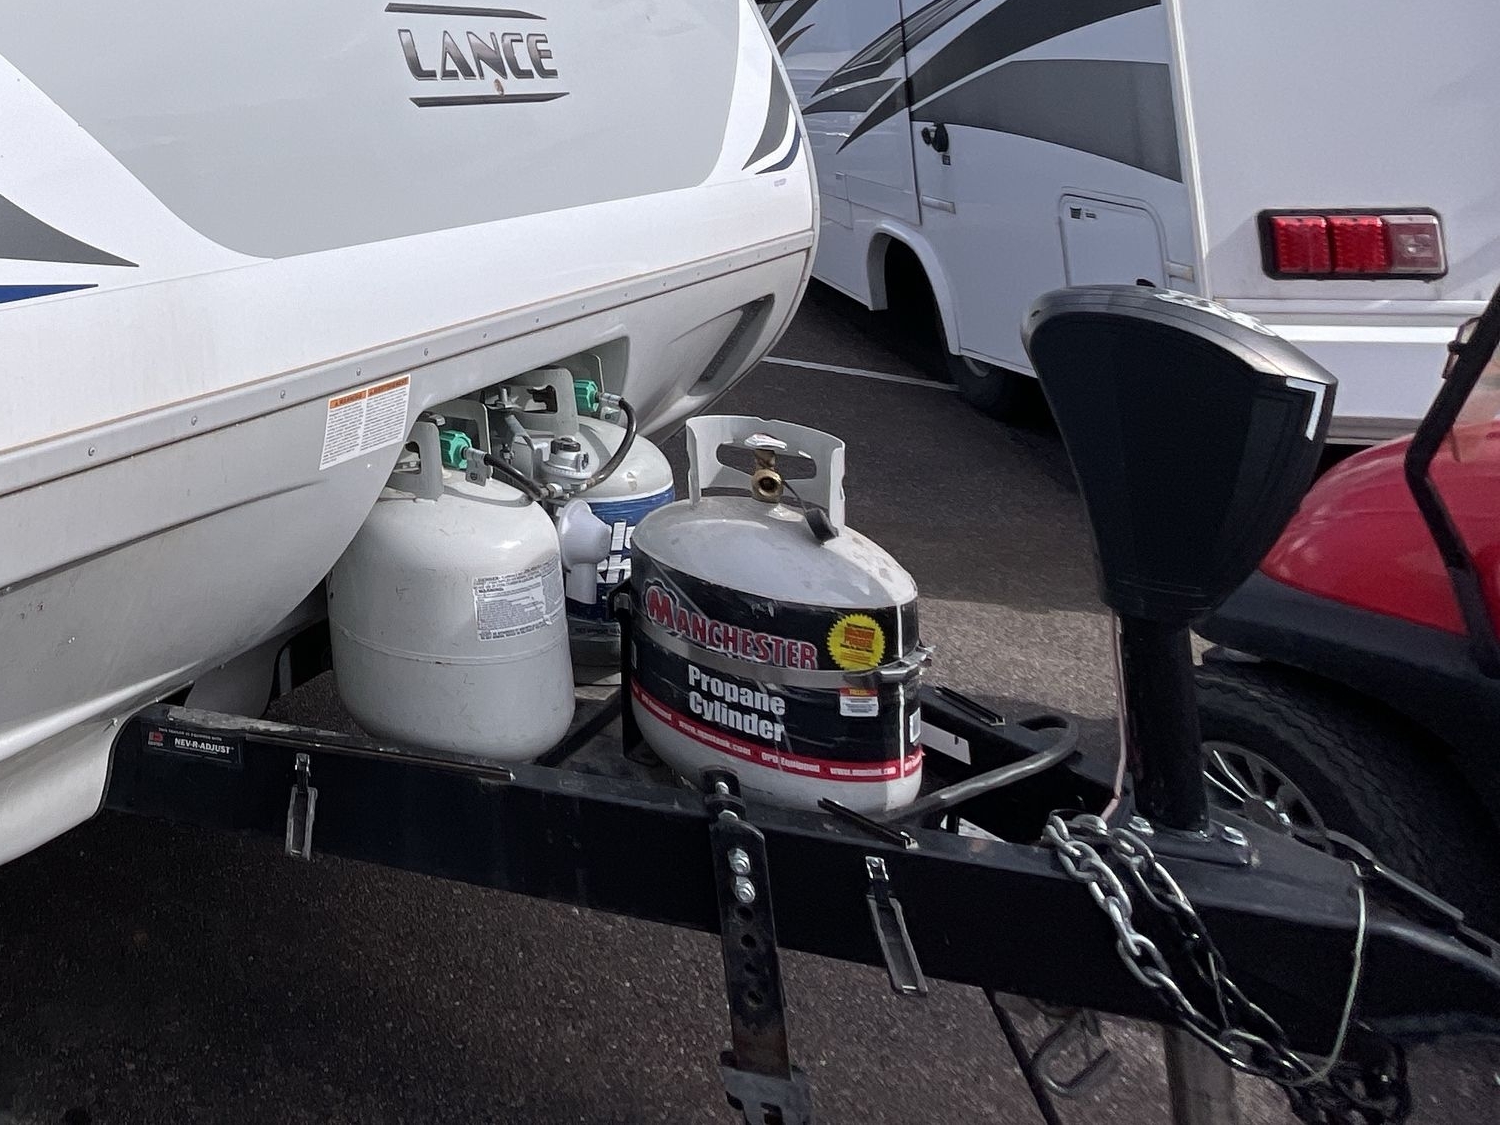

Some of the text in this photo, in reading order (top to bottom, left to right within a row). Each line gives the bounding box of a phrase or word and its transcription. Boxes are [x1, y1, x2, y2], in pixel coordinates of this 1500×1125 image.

[397, 28, 559, 81] LANCE
[687, 664, 786, 716] Propane
[688, 690, 785, 742] Cylinder
